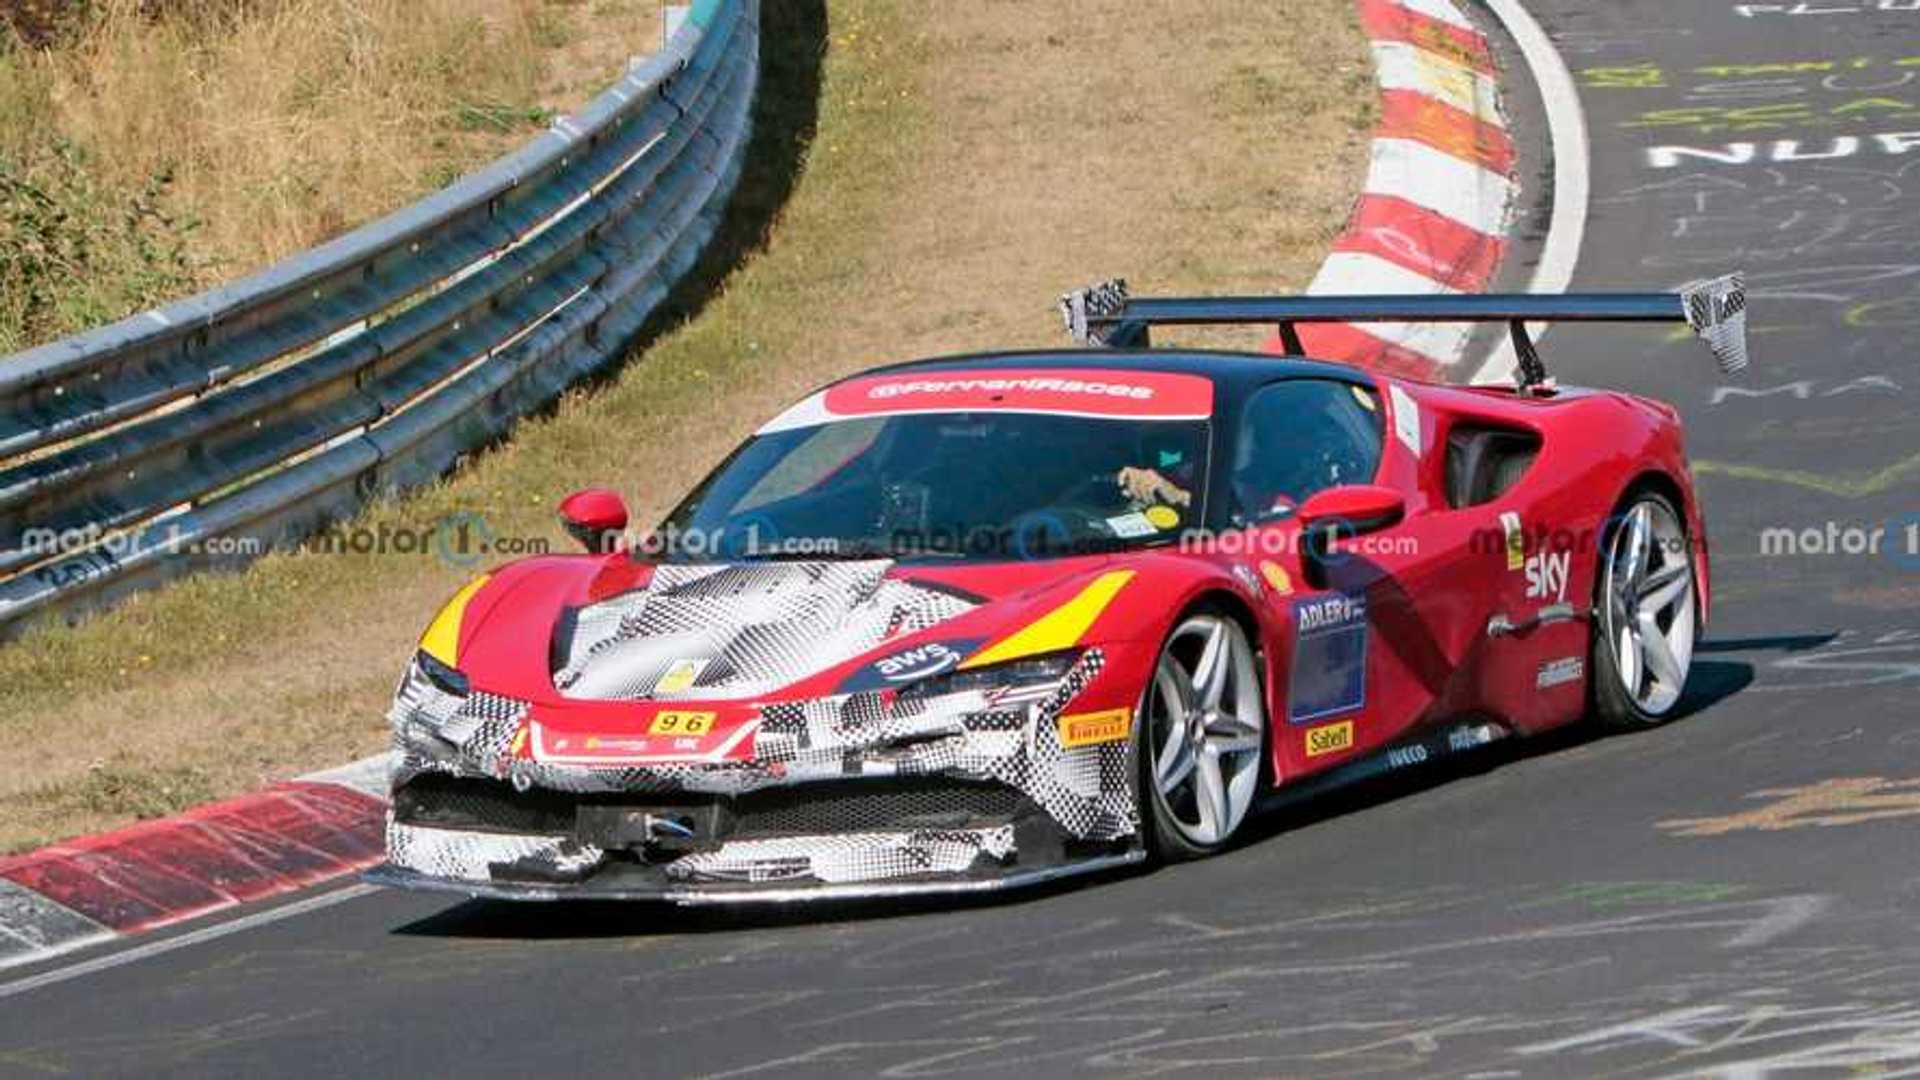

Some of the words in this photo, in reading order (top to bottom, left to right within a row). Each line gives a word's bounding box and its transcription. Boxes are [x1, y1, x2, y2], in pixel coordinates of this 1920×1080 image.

[1524, 549, 1571, 603] sky
[1299, 599, 1344, 630] ADLER
[874, 642, 949, 675] aws
